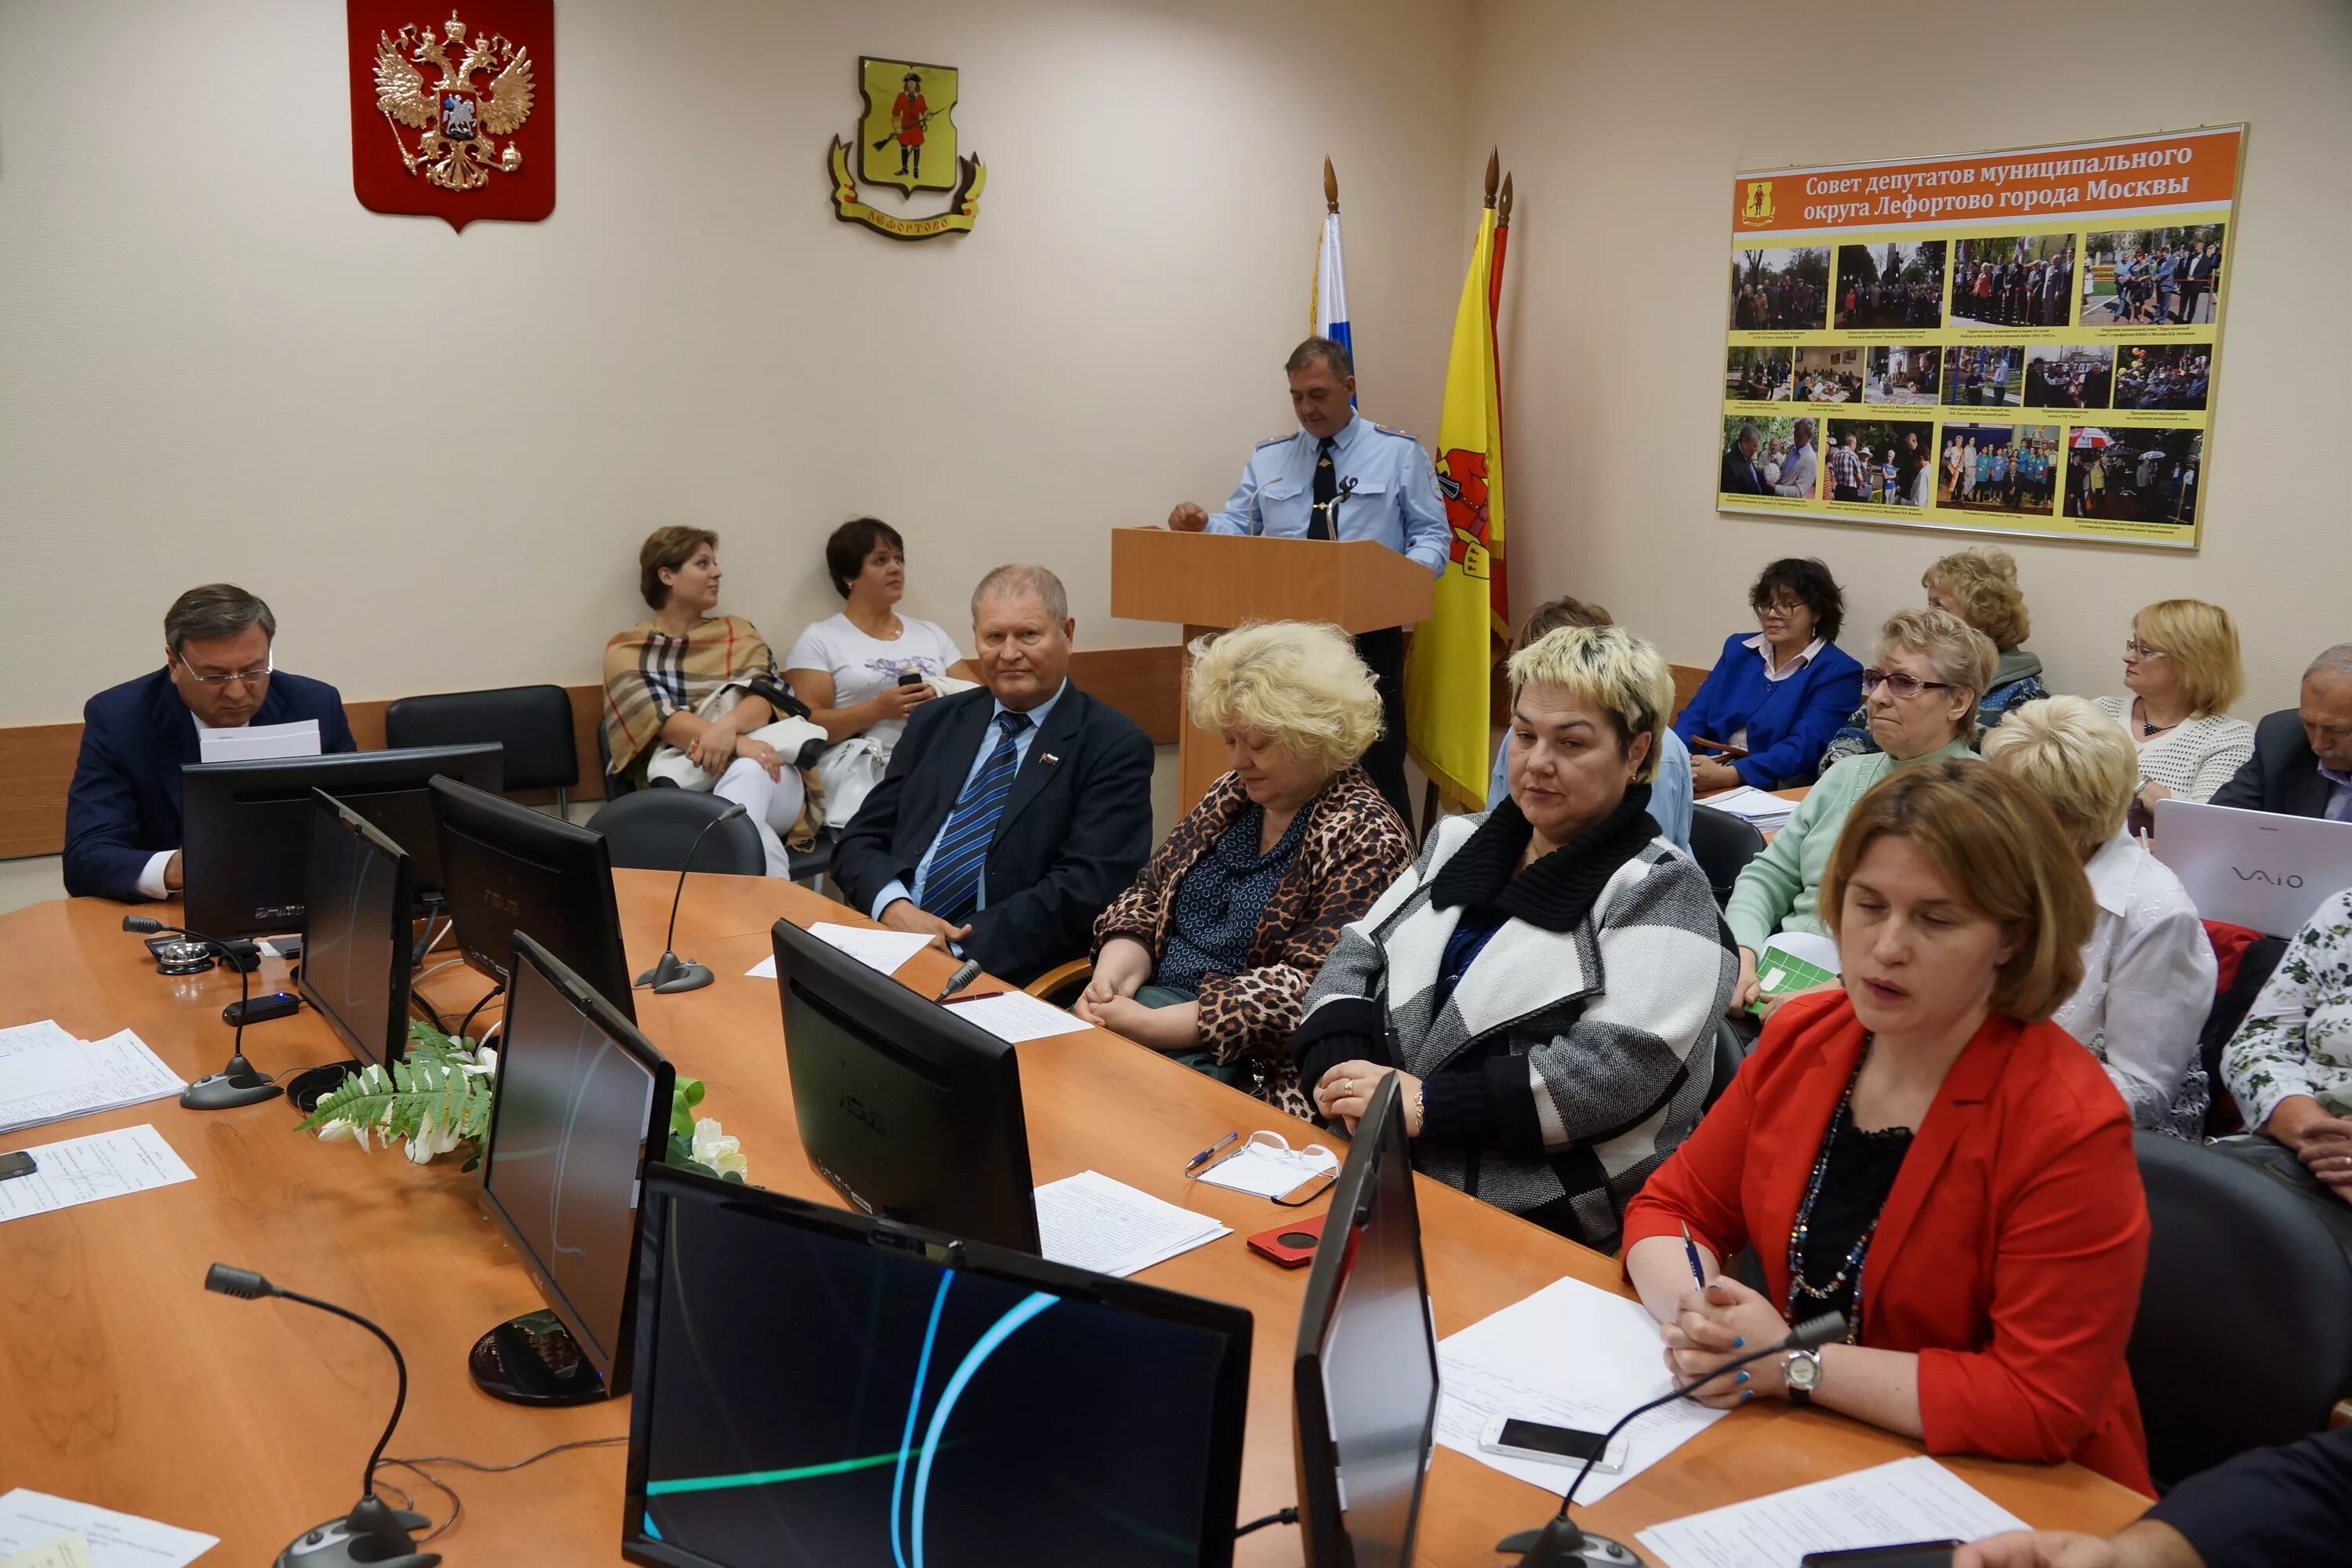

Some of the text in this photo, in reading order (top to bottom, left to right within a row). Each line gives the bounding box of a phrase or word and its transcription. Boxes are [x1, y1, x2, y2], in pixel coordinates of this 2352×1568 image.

[1806, 147, 2193, 195] Совет депутатов муниципального
[1804, 176, 2190, 223] округа Лефортово города Москвы
